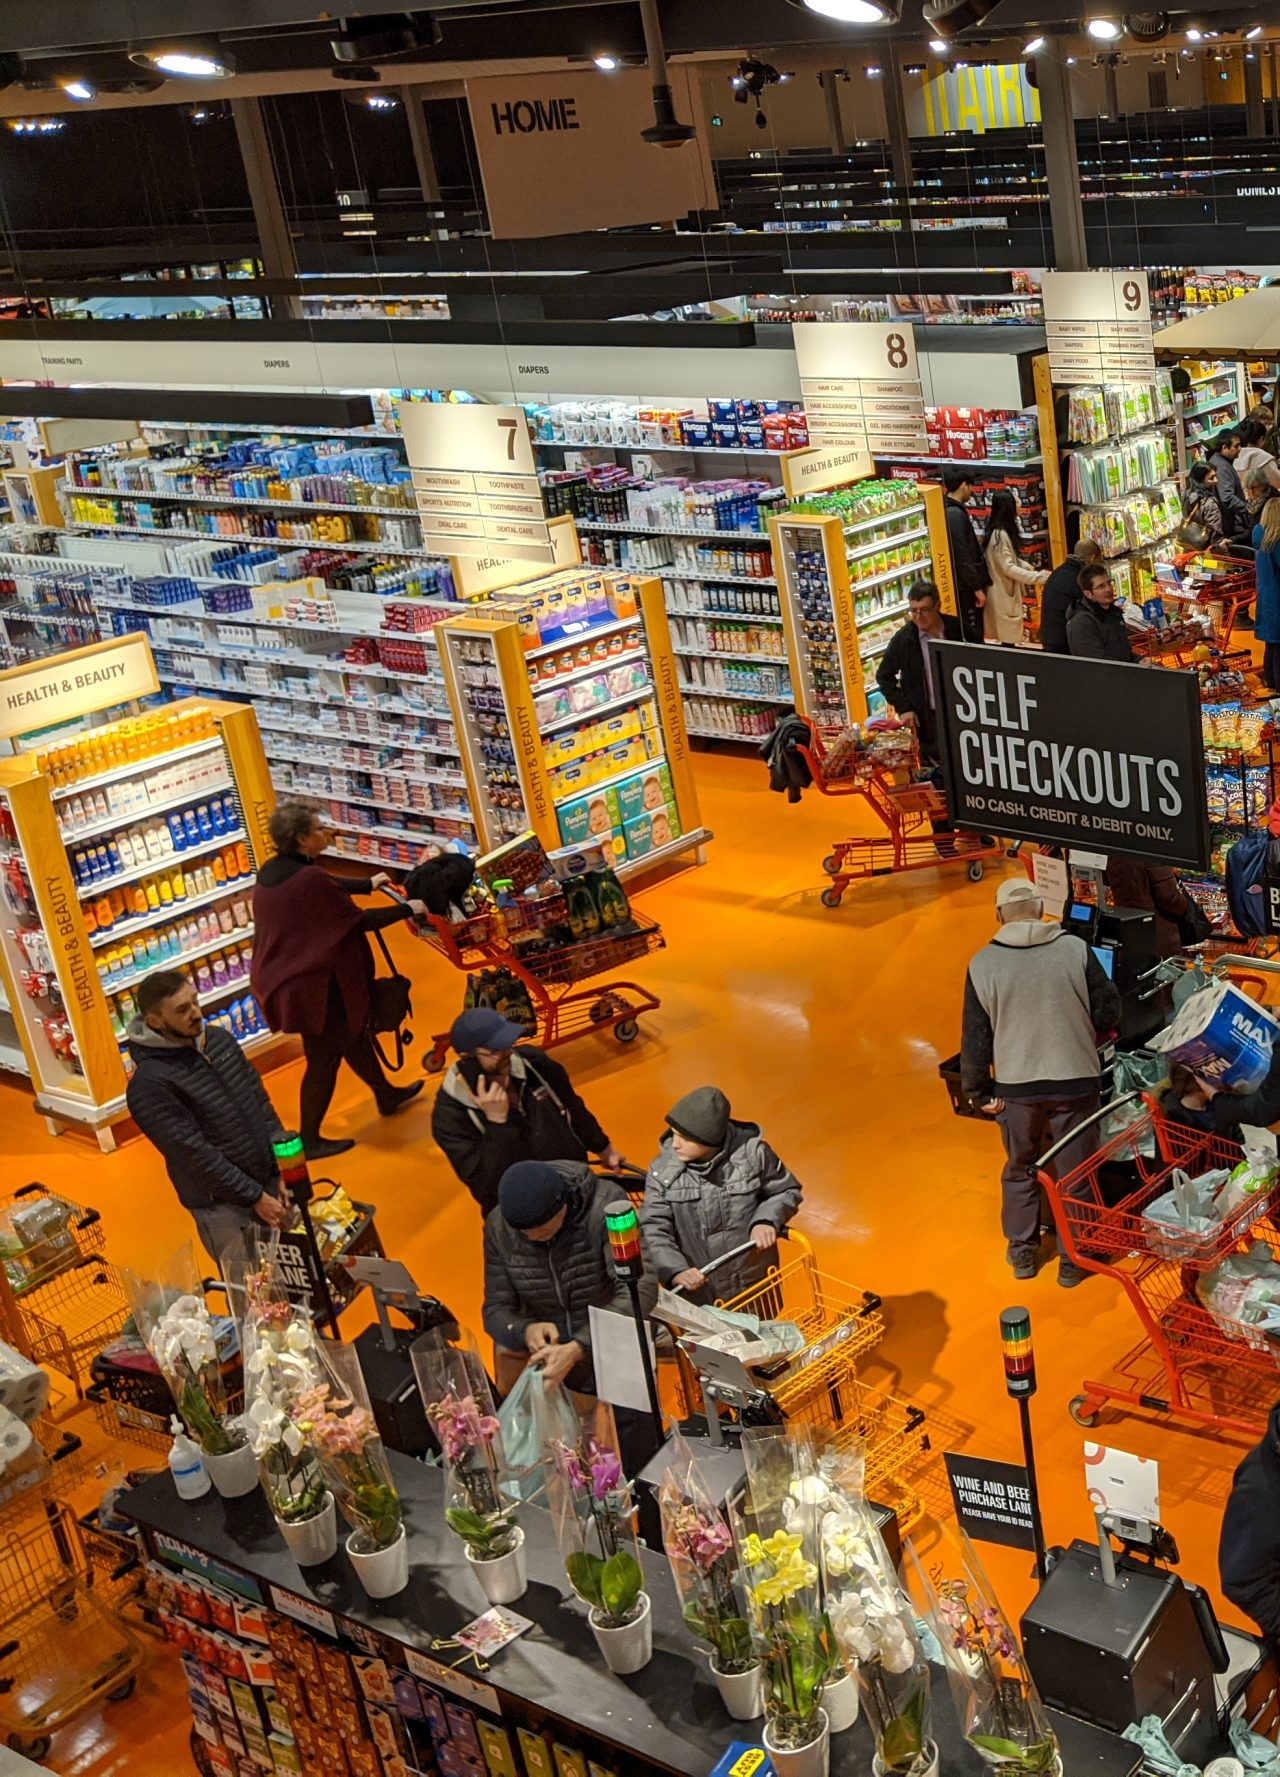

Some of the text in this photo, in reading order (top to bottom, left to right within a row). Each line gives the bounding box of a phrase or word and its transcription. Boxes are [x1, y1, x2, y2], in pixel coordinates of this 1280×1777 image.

[491, 98, 580, 135] HOME
[1122, 281, 1141, 311] 9
[264, 360, 290, 369] DIAPERS
[885, 333, 908, 368] 8
[518, 365, 549, 376] DIAPERS
[496, 418, 518, 461] 7
[945, 429, 974, 440] HUGGIES
[426, 477, 460, 486] MOUTHWASH
[801, 452, 859, 476] HEALTH & BEAUTY
[422, 498, 472, 508] SPORTS NUTRITION
[489, 481, 525, 490] TOOTHPASTE
[437, 520, 467, 530] ORAL CARE
[490, 503, 533, 513] TOOTHBRUSHES
[496, 525, 533, 535] DENTAL CARE
[939, 552, 950, 594] BEAUTY
[838, 588, 851, 630] BEAUTY
[658, 654, 675, 701] BEAUTY
[846, 641, 859, 685] HEALTH
[7, 662, 126, 710] HEALTH & BEAUTY
[952, 666, 1038, 731] SELF
[670, 716, 685, 761] HEALTH
[516, 705, 548, 819] HEALTH & BEAUTY
[958, 729, 1183, 817] CHECKOUTS
[966, 794, 1174, 842] NO CASH. CREDIT & DEBIT ONLY.
[45, 876, 95, 1013] HEALTH & BEAUTY
[1231, 1011, 1274, 1055] MAX
[952, 1473, 981, 1492] WINE
[984, 1481, 1005, 1498] AND
[958, 1489, 1008, 1511] PURCHASE
[962, 1507, 1018, 1526] PLEASE HAVE YOUR ID
